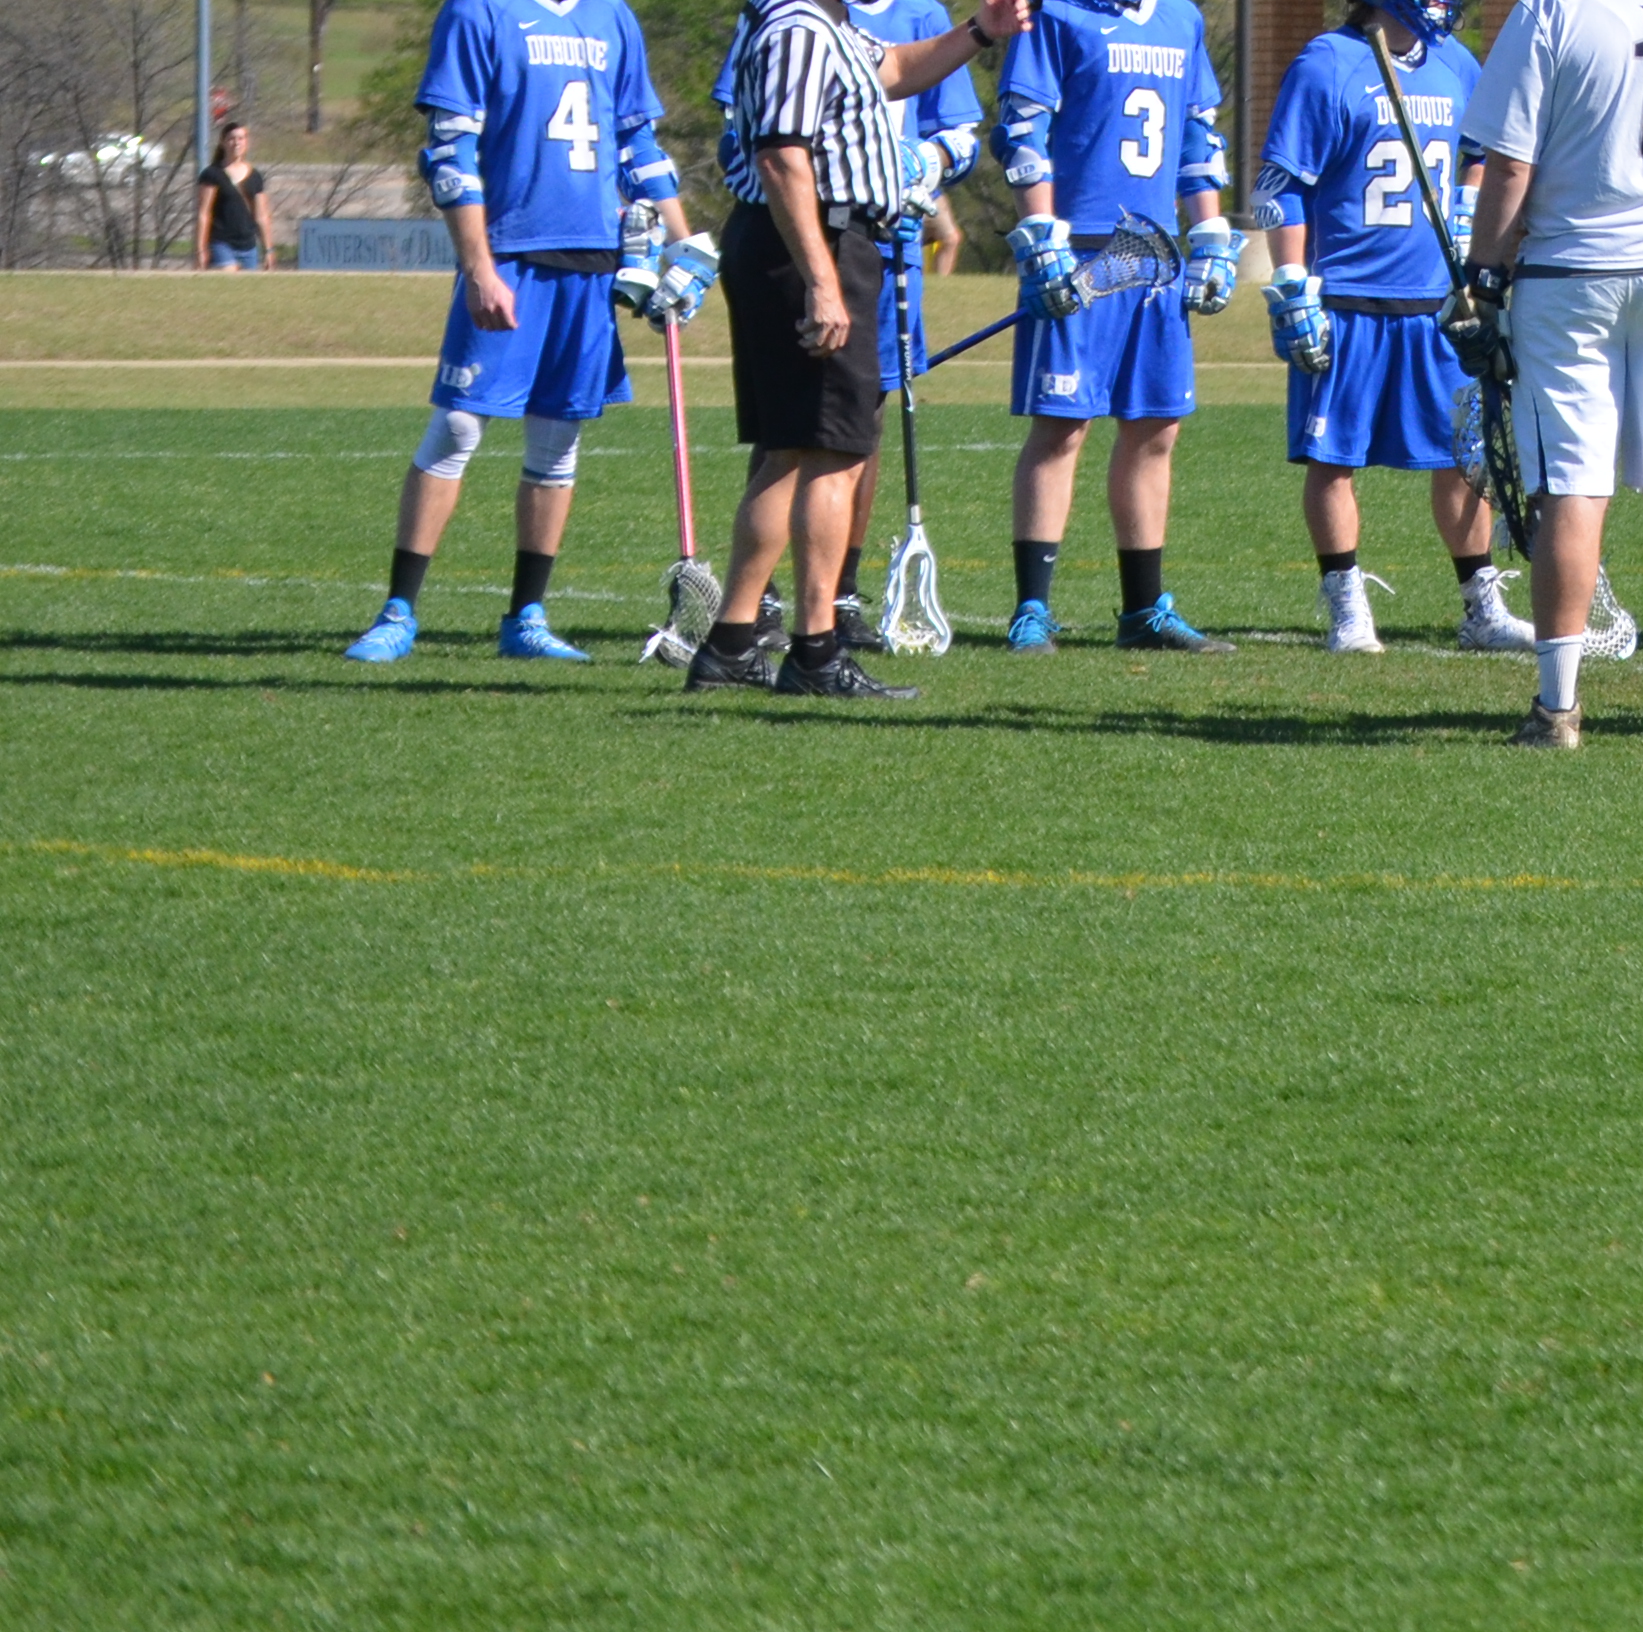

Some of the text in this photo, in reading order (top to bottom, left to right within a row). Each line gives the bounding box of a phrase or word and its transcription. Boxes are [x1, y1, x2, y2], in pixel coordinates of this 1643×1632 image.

[525, 34, 608, 72] DUBUQUE
[1107, 42, 1186, 79] DUBUQUE
[546, 80, 600, 172] 4
[1118, 85, 1167, 180] 3
[1362, 138, 1452, 228] 23
